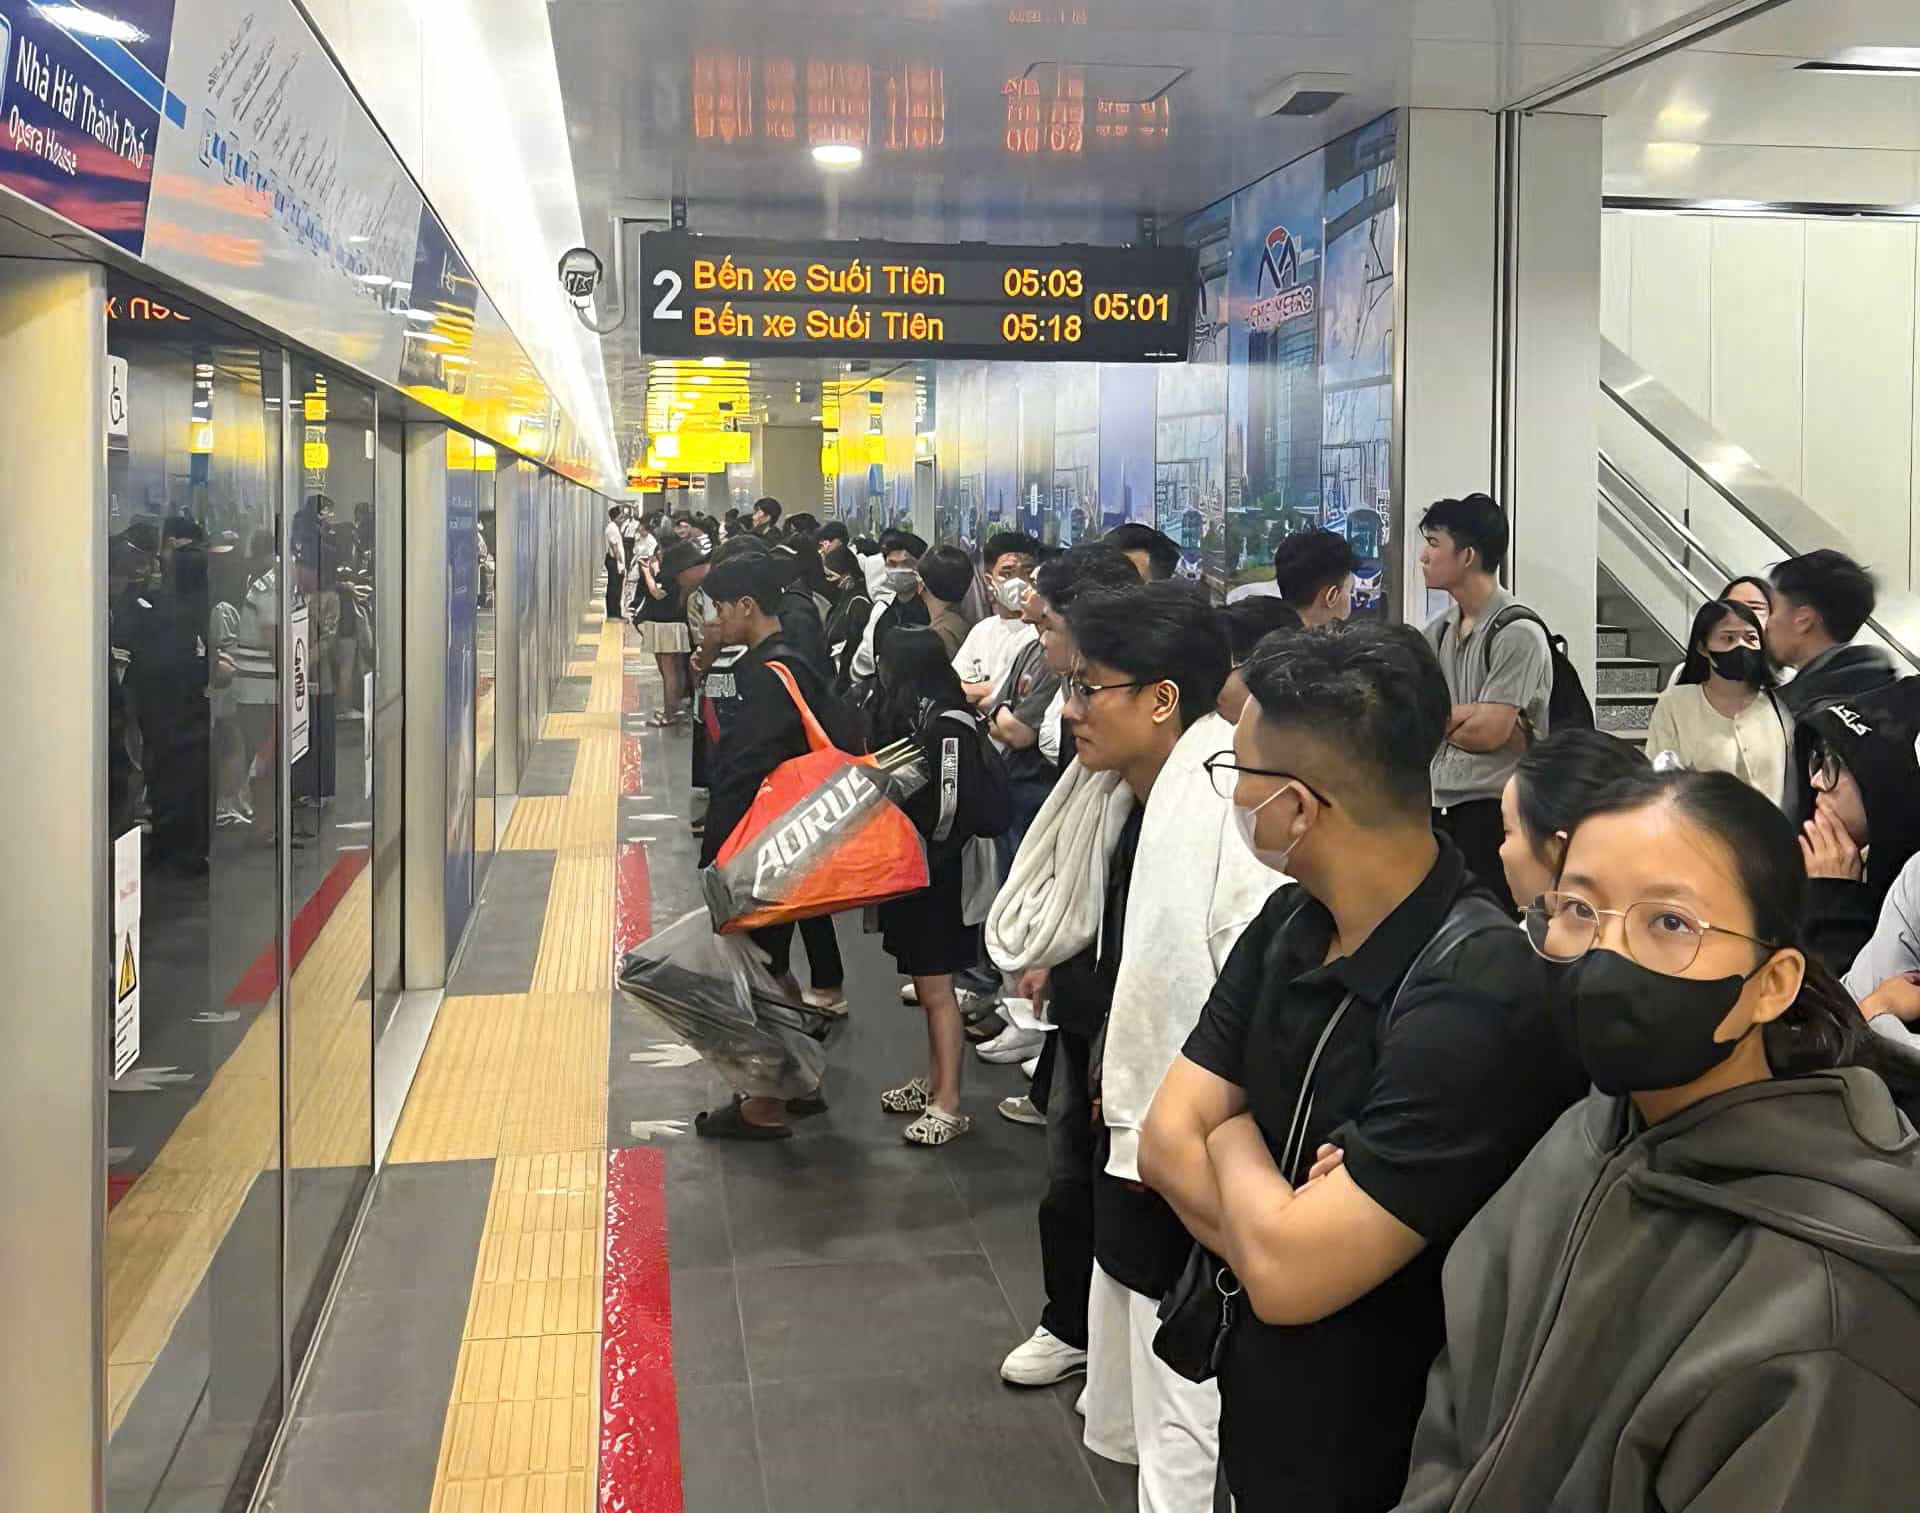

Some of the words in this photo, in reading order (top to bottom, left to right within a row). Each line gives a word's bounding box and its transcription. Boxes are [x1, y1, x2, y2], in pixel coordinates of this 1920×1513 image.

[16, 36, 50, 102] Nhà
[81, 85, 120, 153] Thành
[9, 104, 43, 157] Opera
[652, 269, 683, 321] 2
[694, 255, 753, 290] Bến
[763, 268, 797, 292] xe
[806, 259, 872, 294] Suối
[882, 266, 945, 295] Tiên
[1003, 268, 1084, 298] 05:03
[694, 302, 753, 337] Bến
[763, 315, 797, 338] xe
[806, 305, 871, 340] Suối
[881, 312, 944, 341] Tiên
[1001, 313, 1082, 342] 05:18
[1093, 292, 1170, 321] 05:01
[752, 765, 877, 898] AORUS
